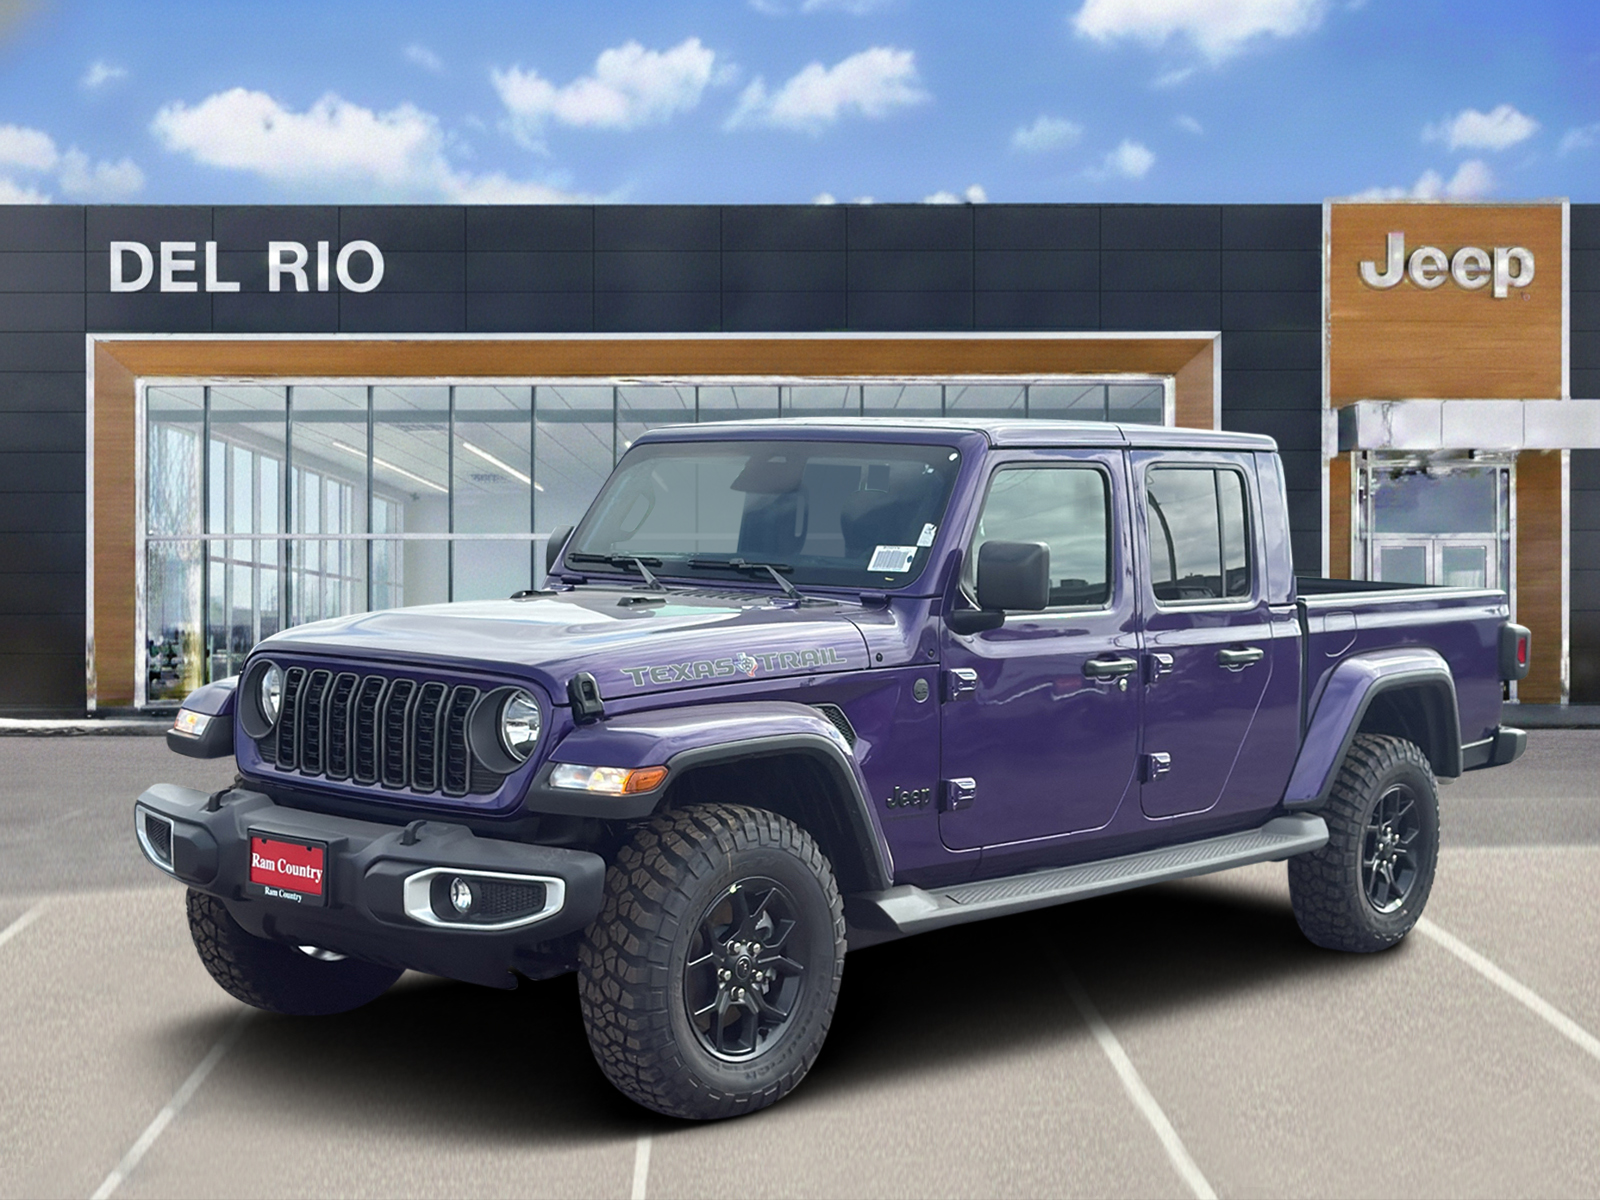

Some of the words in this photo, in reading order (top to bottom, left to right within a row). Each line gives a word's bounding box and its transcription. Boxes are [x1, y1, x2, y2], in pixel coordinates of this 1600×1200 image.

[110, 241, 241, 292] DEL
[268, 240, 385, 293] RIO
[1359, 231, 1536, 299] Jeep
[621, 658, 735, 686] TEXAS
[756, 647, 847, 672] TRAIL
[886, 785, 931, 811] Jeep
[252, 852, 275, 871] Ram
[277, 858, 323, 883] Country
[265, 887, 278, 897] Ram
[279, 889, 302, 903] Country
